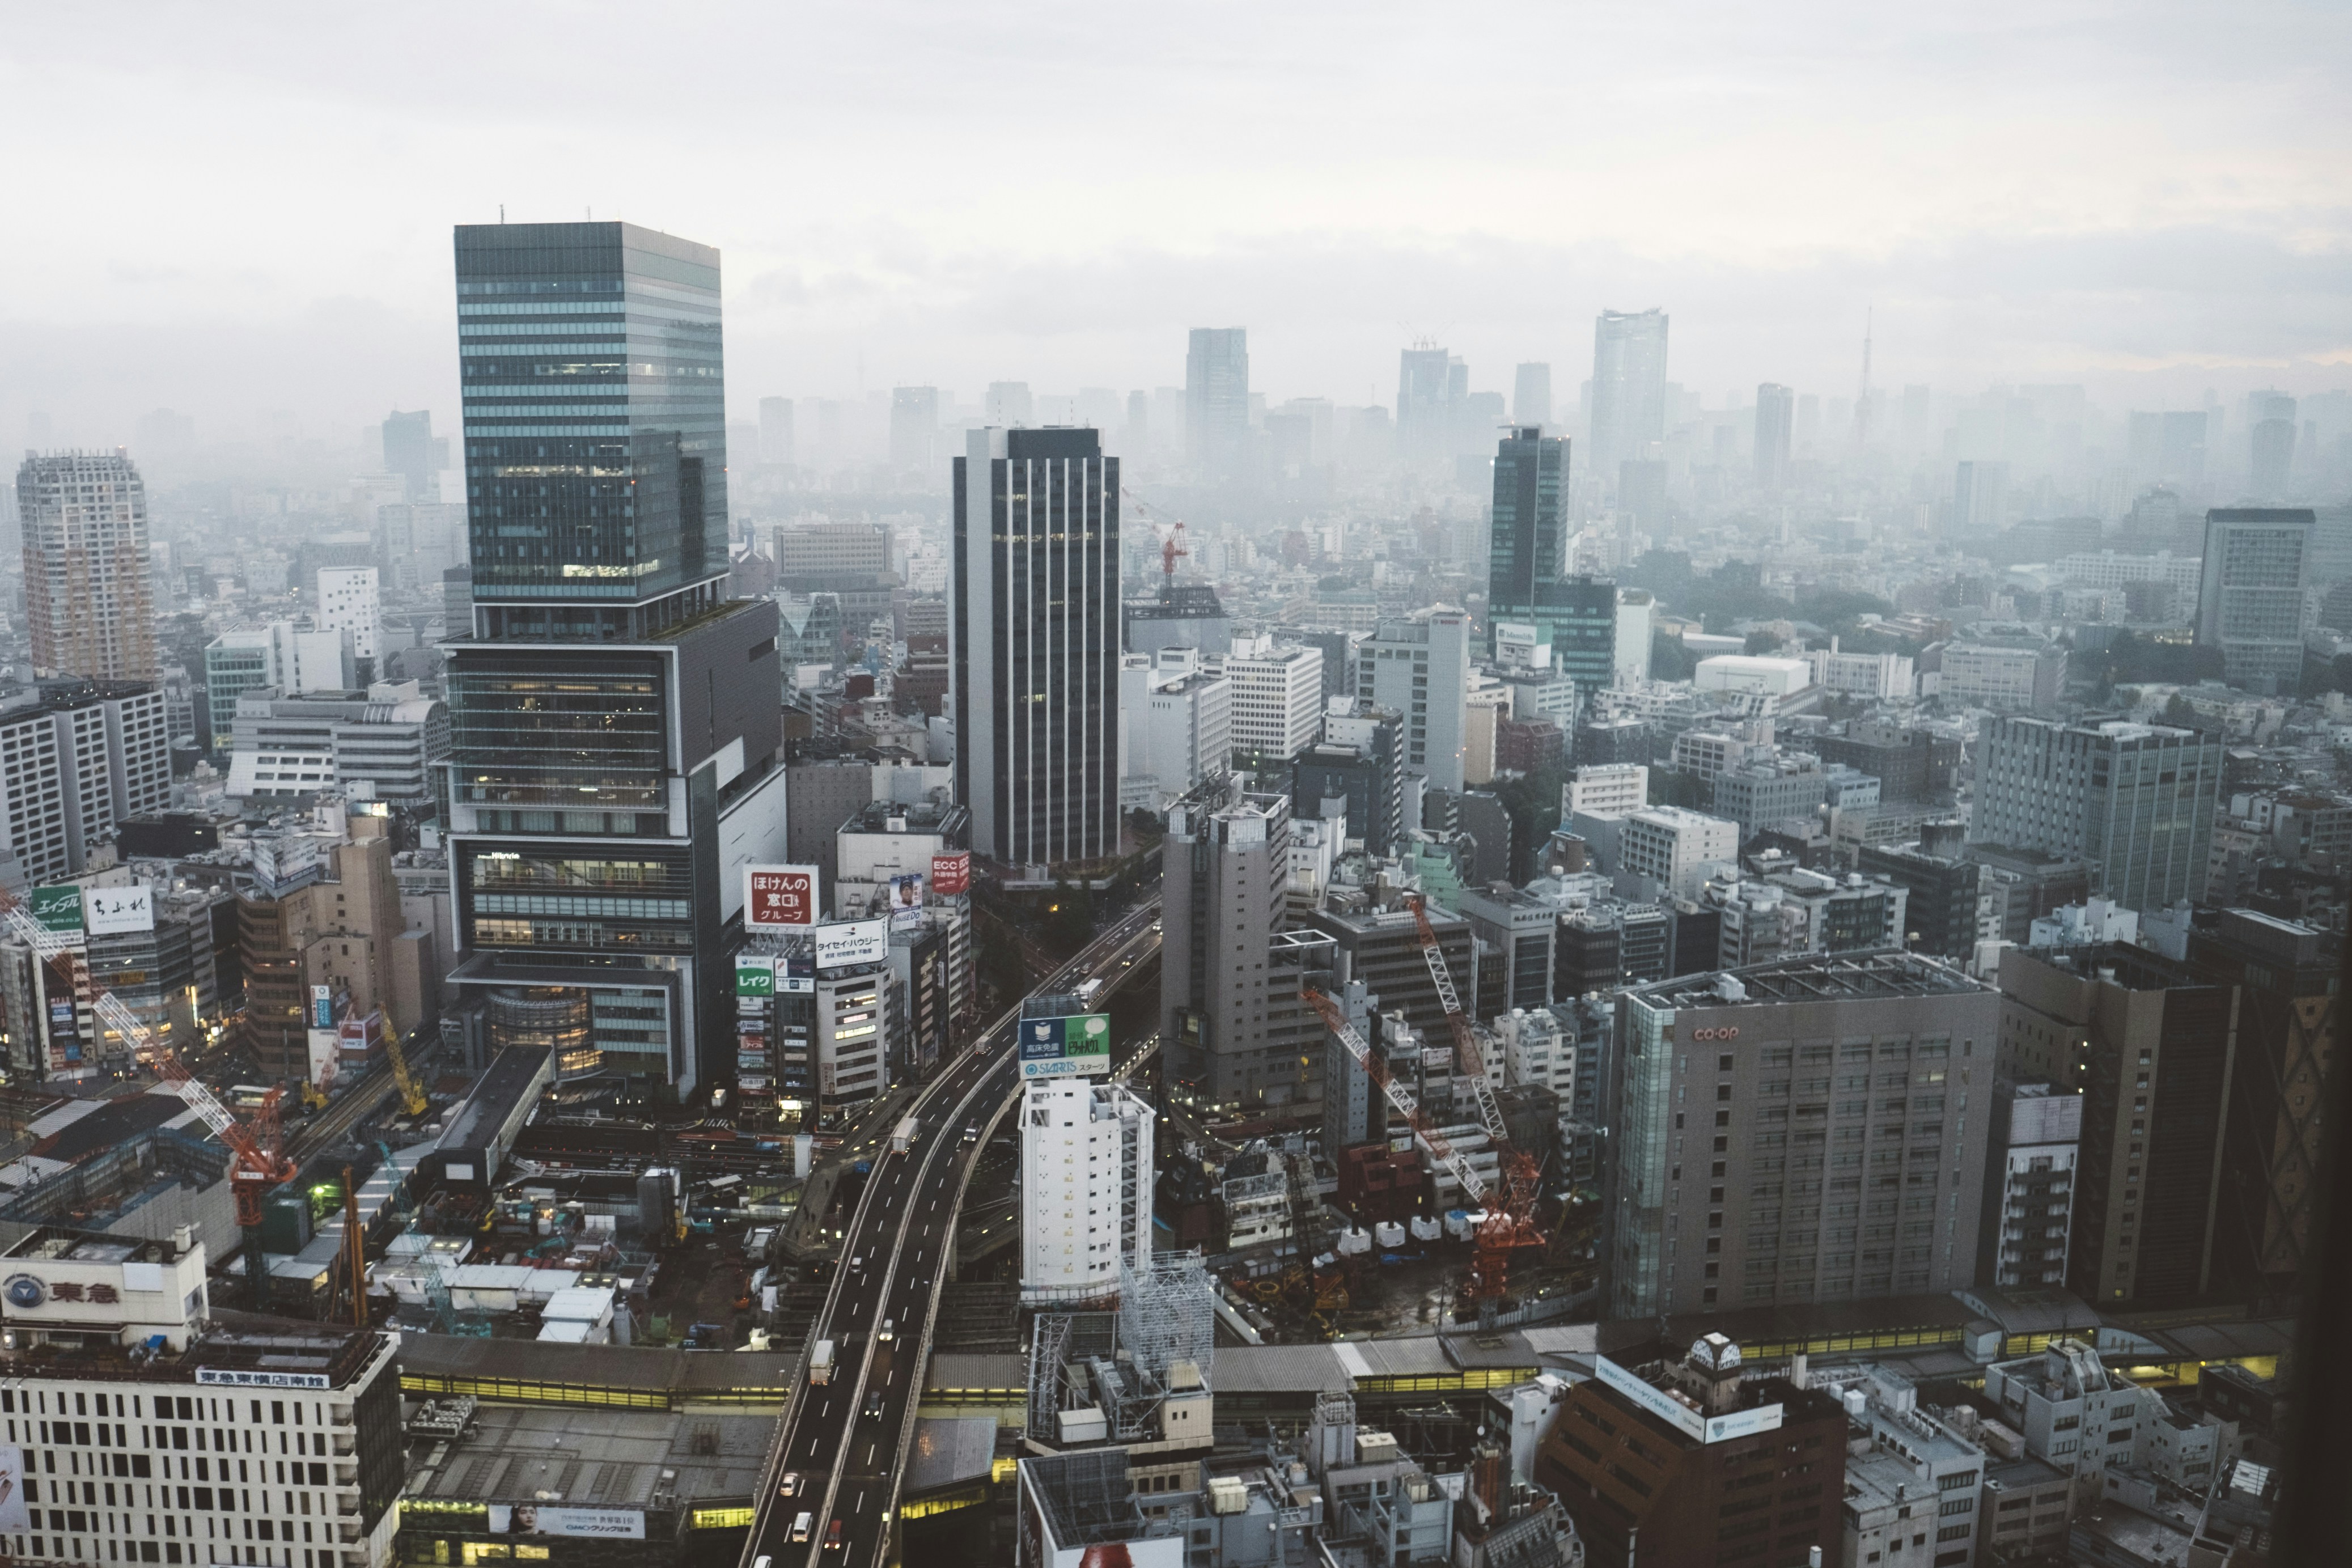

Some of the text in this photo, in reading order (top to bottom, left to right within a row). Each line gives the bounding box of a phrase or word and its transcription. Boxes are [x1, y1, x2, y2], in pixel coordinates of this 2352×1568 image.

[1506, 631, 1533, 641] Manulife
[933, 861, 957, 870] ECC
[959, 856, 969, 869] ECC
[754, 876, 808, 891] ほけんの
[33, 893, 80, 915] エイブル
[94, 897, 146, 916] ちふれ
[767, 893, 795, 907] 窓口
[761, 910, 803, 920] グループ
[817, 936, 879, 951] タイセイ・ハウジー
[739, 975, 770, 987] レイク
[49, 1282, 119, 1303] 東急
[200, 1372, 324, 1387] 東急東横店南館
[600, 1516, 635, 1524] 世界第1位
